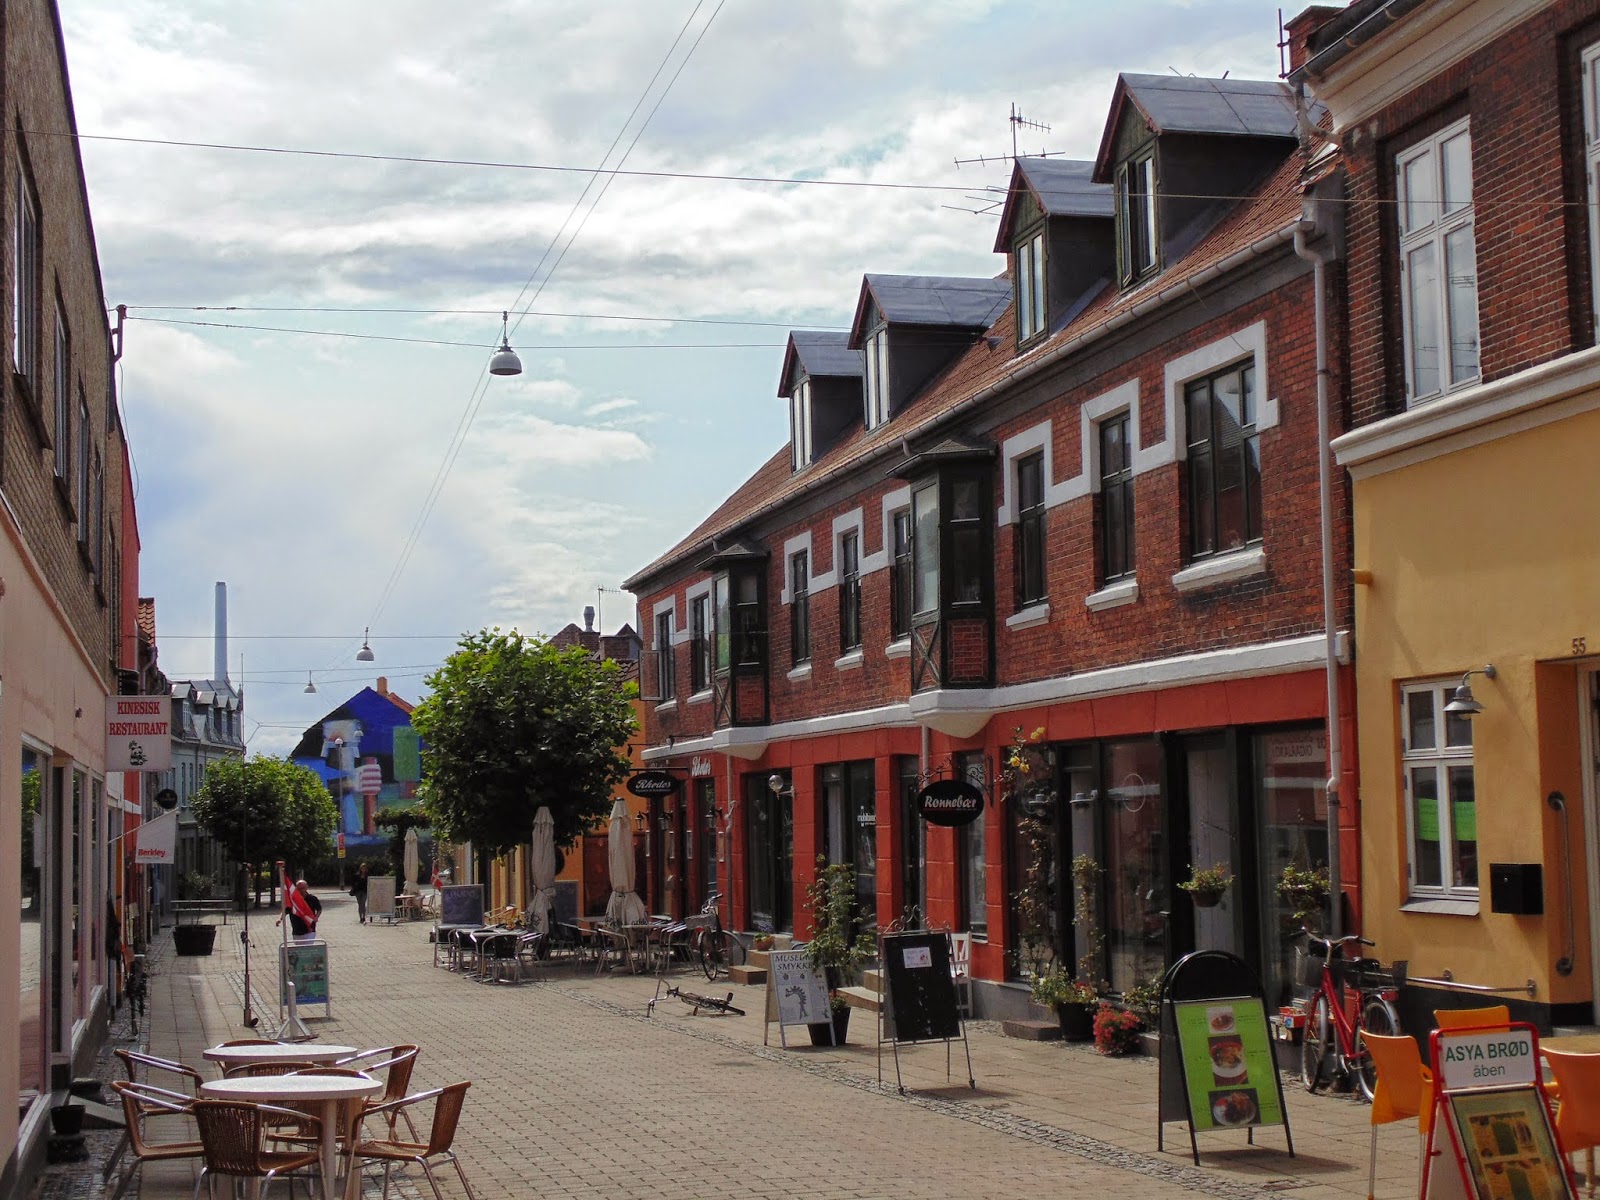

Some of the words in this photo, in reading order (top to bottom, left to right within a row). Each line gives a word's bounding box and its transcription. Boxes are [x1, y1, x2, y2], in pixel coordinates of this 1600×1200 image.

[1572, 637, 1586, 655] 55
[117, 701, 160, 714] KINESISK
[109, 722, 168, 735] RESTAURANT
[635, 779, 671, 789] Rhodes
[138, 848, 166, 858] Berkley
[1445, 1045, 1485, 1062] ASYA
[1487, 1040, 1529, 1059] BRØD
